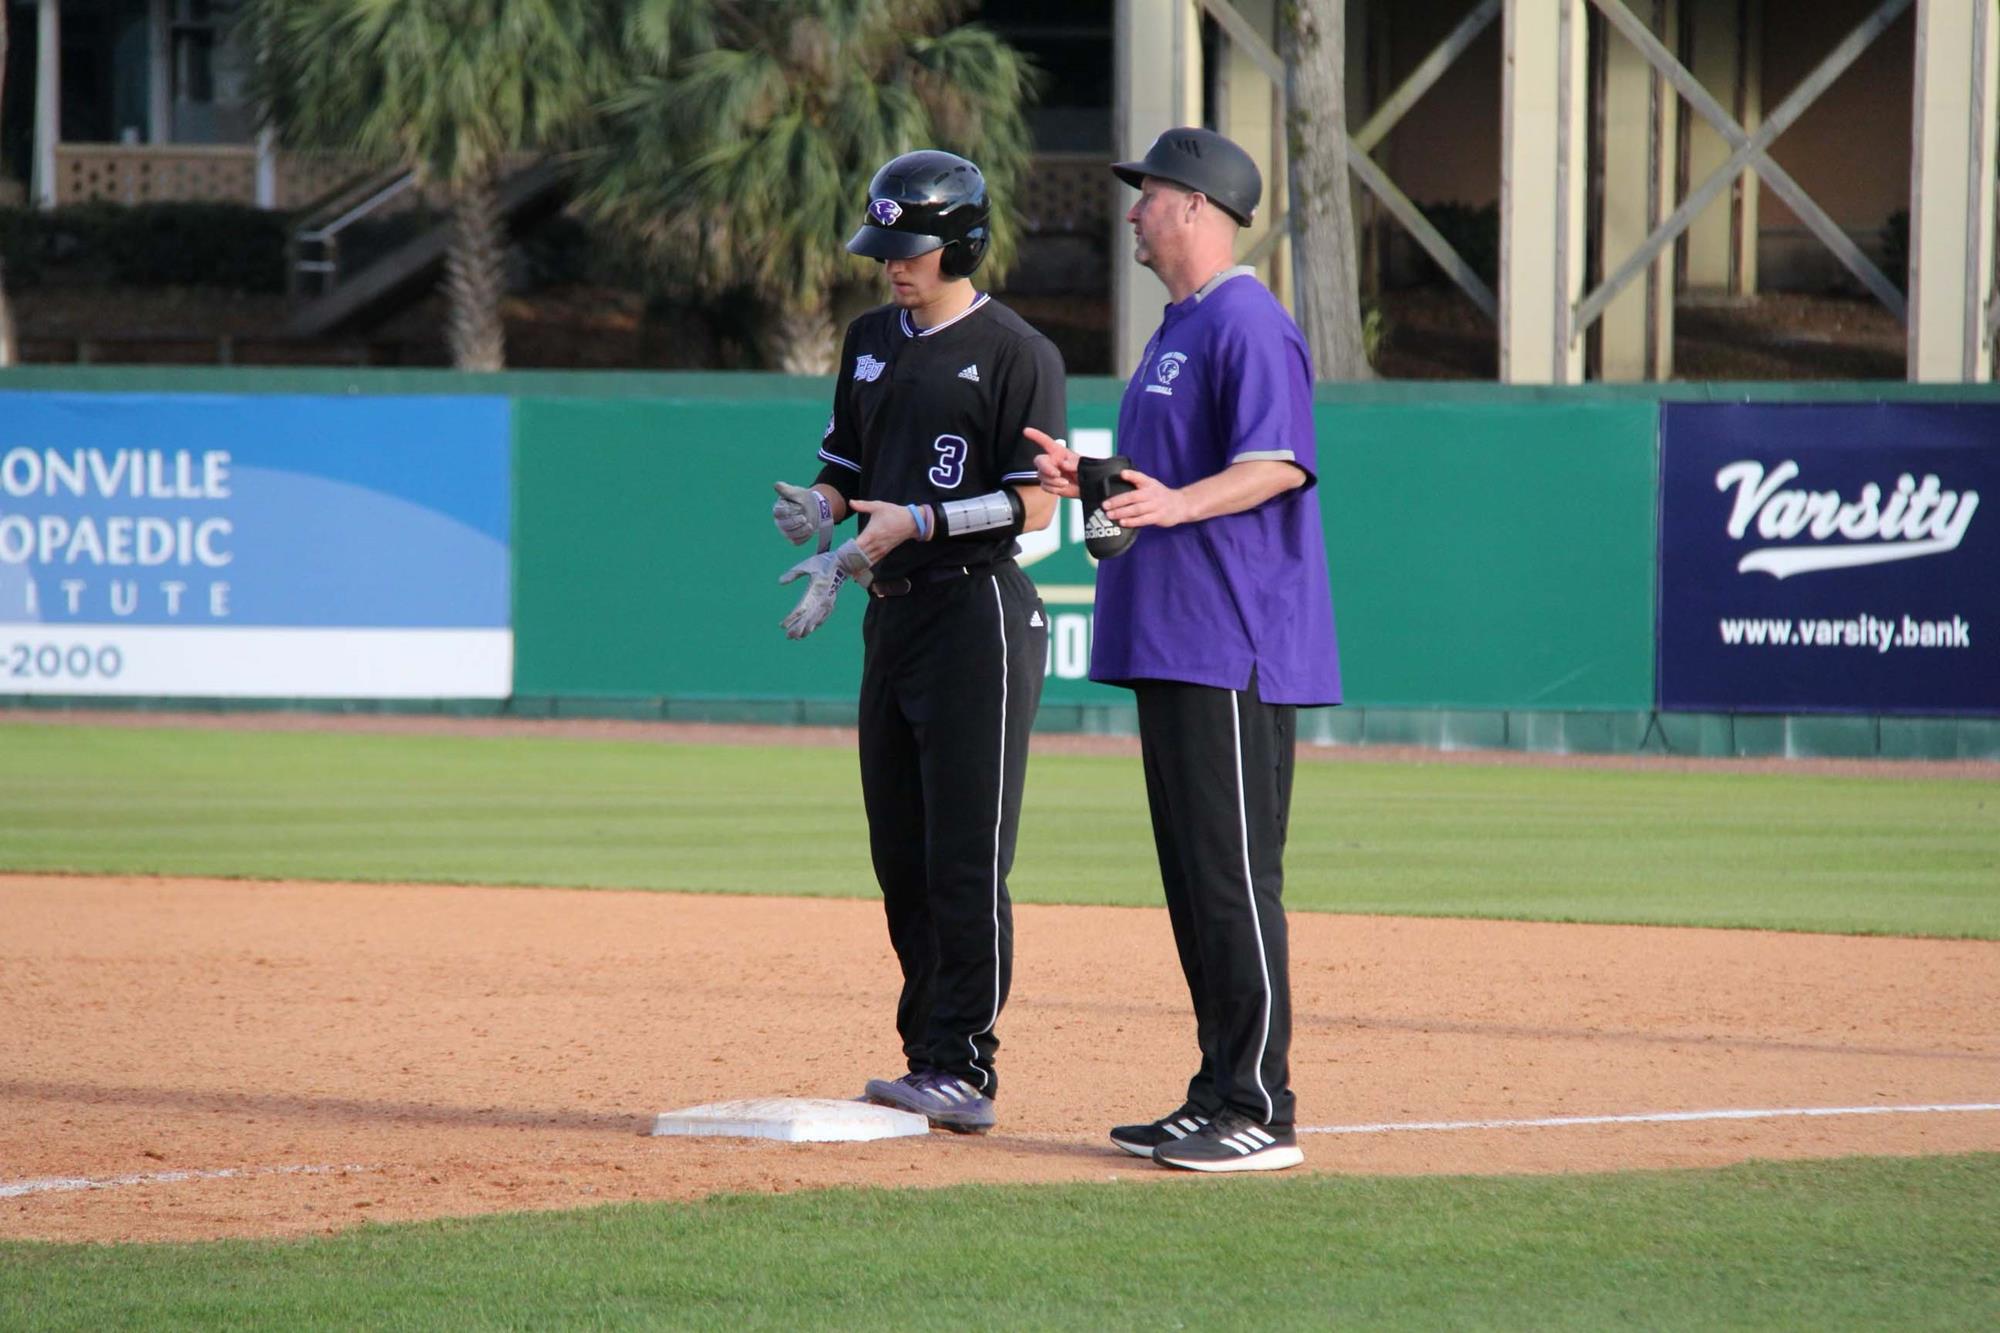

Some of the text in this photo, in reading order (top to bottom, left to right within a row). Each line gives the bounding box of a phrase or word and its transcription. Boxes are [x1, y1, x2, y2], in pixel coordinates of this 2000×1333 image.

[1, 447, 232, 498] ONVILLE
[929, 434, 968, 489] 3
[1715, 459, 1980, 552] Varsity
[0, 515, 233, 567] OPAEDIC
[1085, 526, 1121, 539] adidas
[1720, 613, 1970, 653] www.varsity.bank
